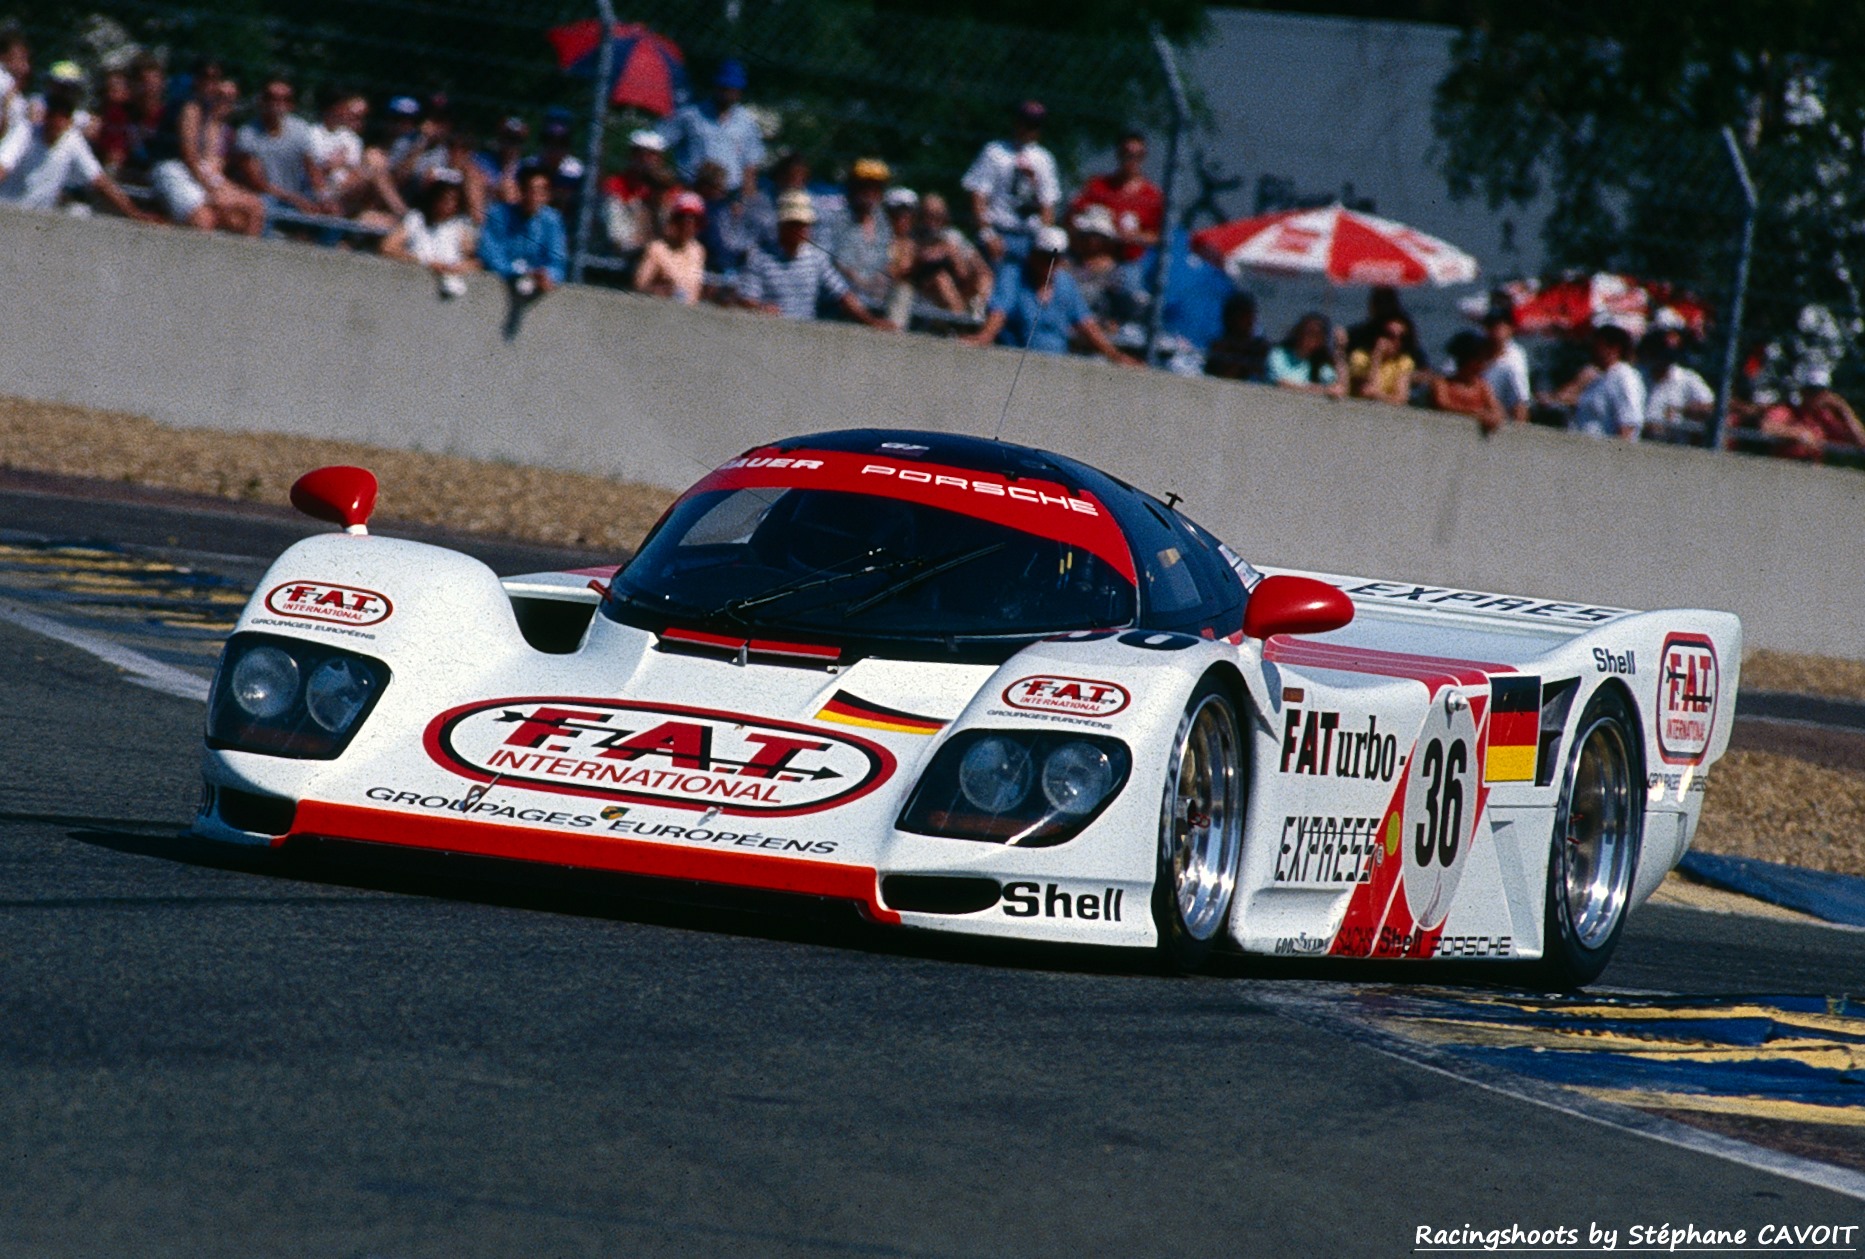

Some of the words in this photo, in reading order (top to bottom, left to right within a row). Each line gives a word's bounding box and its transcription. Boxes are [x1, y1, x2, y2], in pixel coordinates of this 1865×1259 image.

[861, 464, 1099, 517] PORSCHE
[251, 618, 313, 631] GROUPAGES
[282, 602, 364, 621] INTERNATIONAL
[1592, 647, 1636, 675] Shell
[986, 709, 1049, 721] GROUPAGES
[1020, 696, 1101, 712] INTERNATIONAL
[486, 749, 782, 804] INTERNATIONAL
[1415, 737, 1468, 868] 36
[366, 786, 597, 828] GROUPAGES
[608, 819, 839, 855] EUROPÉENS
[1274, 816, 1381, 882] EXPRESS
[1002, 881, 1124, 922] Shell
[1379, 926, 1423, 954] Shell
[1430, 936, 1512, 956] PORSCHE
